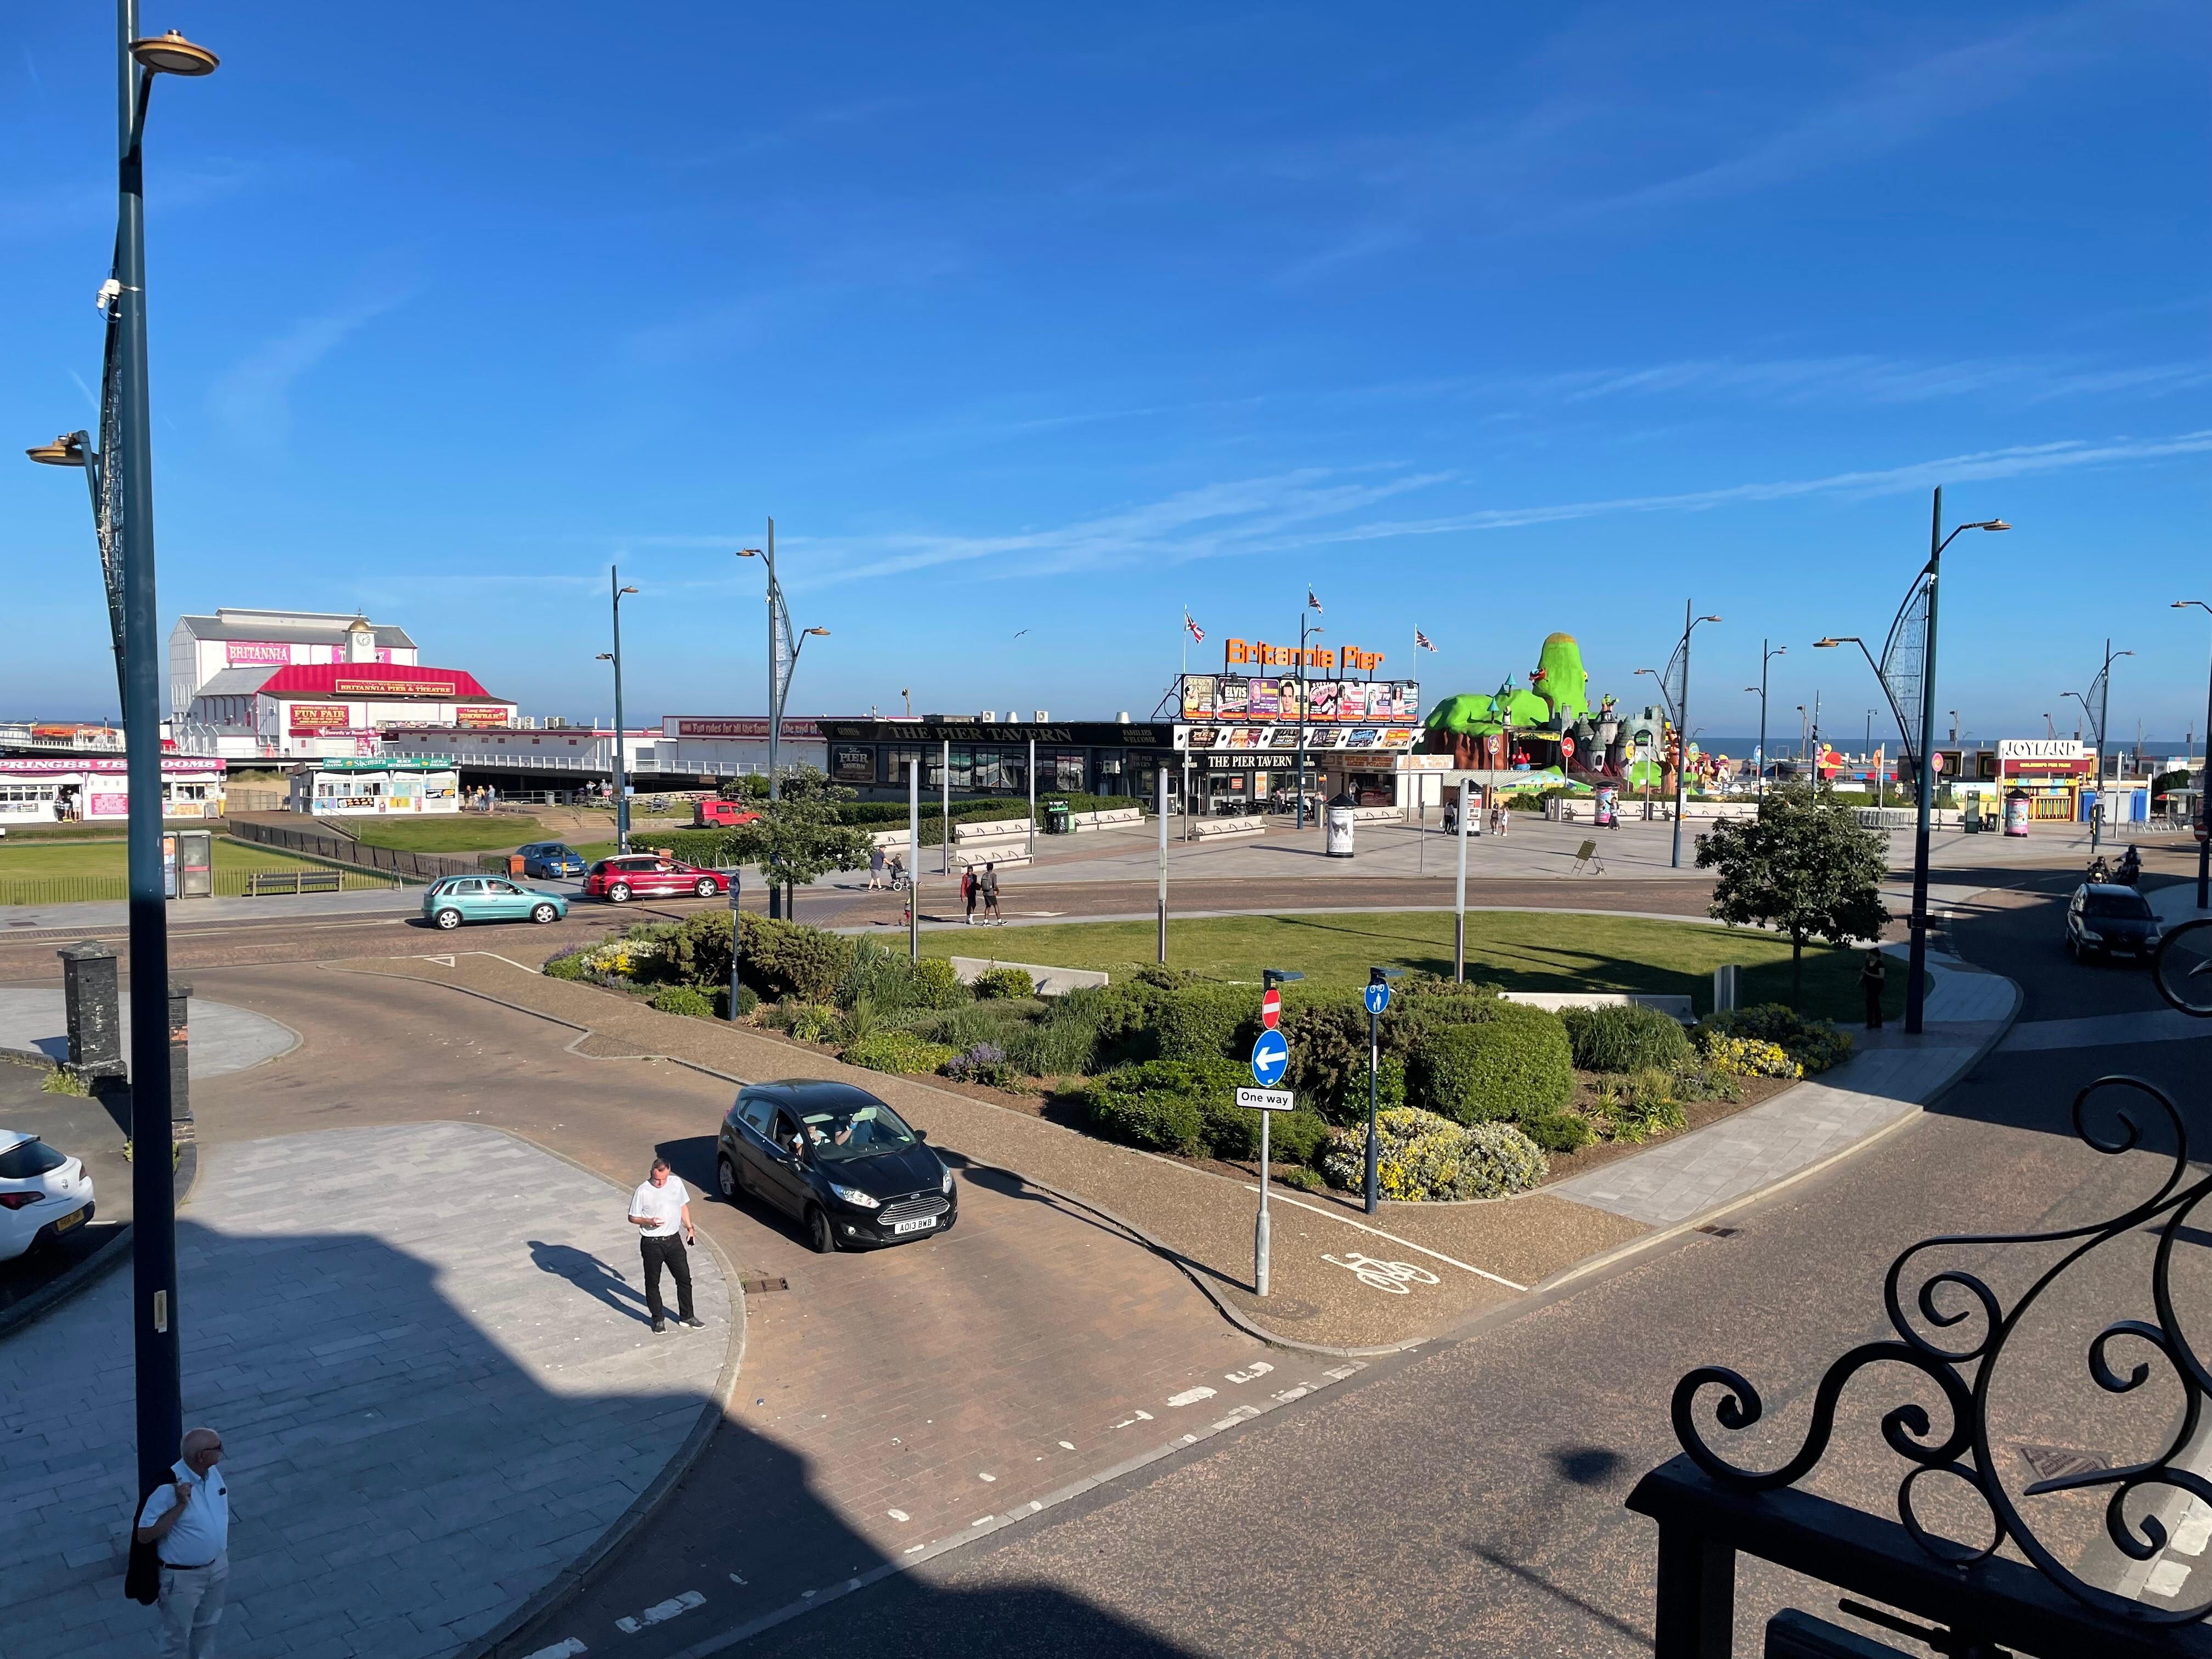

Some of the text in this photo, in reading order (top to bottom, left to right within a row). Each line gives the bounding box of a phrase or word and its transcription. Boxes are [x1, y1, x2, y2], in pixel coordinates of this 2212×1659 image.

[228, 645, 288, 662] BRITANNIA
[1226, 639, 1385, 670] Britannia Pier
[1224, 686, 1247, 698] ELVIS
[692, 723, 704, 733] Fun
[706, 723, 722, 733] rides
[723, 723, 732, 733] for
[733, 723, 741, 733] all
[742, 723, 753, 734] the
[783, 723, 794, 734] the
[795, 723, 808, 735] end
[888, 727, 1073, 742] THE PIER TAVERN
[2006, 742, 2077, 756] JOYLAND
[839, 752, 869, 763] PIER
[1208, 755, 1293, 767] THE PIER TAVERN
[1242, 1092, 1288, 1105] One way
